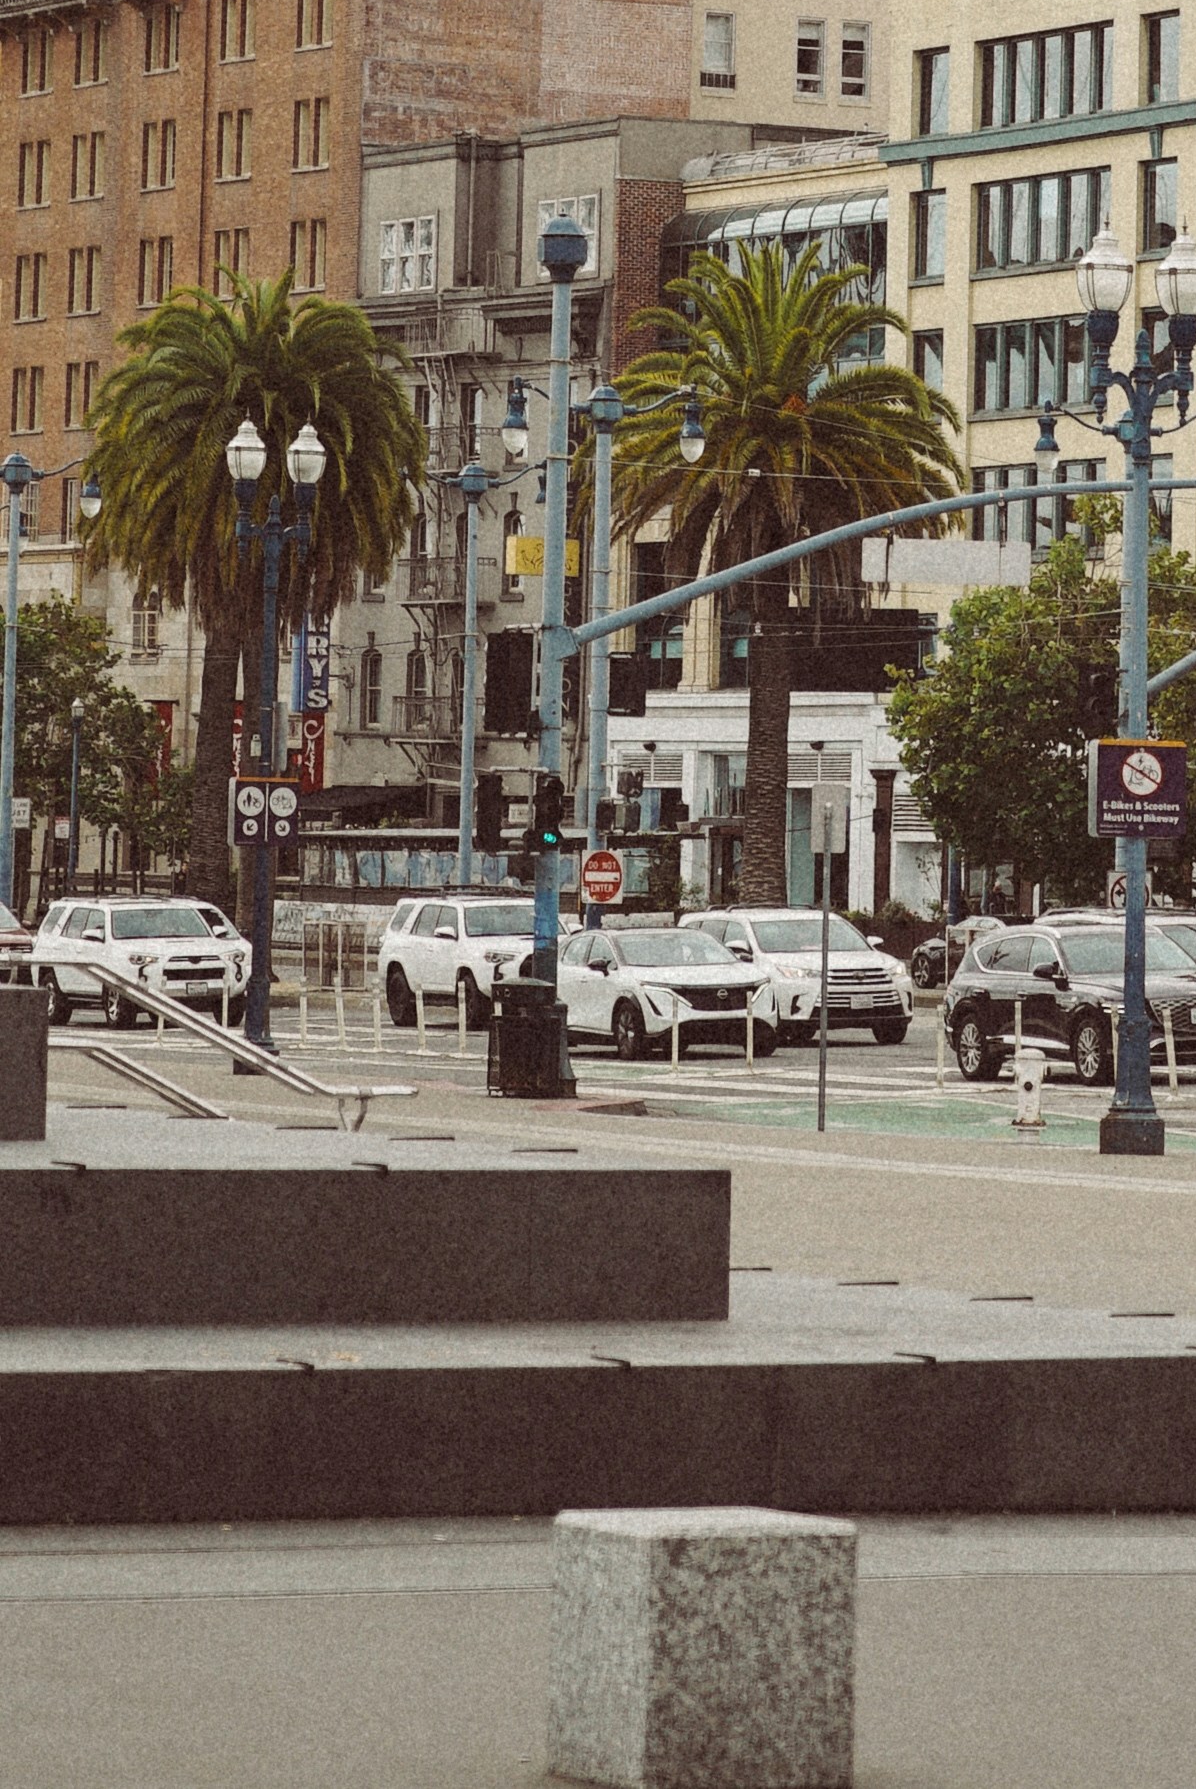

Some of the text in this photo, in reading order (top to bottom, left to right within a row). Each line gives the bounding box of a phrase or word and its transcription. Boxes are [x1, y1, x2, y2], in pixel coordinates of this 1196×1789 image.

[1102, 800, 1180, 812] E-Bikes & Scooters
[1103, 812, 1179, 825] Must Use Bikeway
[588, 860, 616, 870] DO NOT
[590, 883, 614, 893] ENTER
